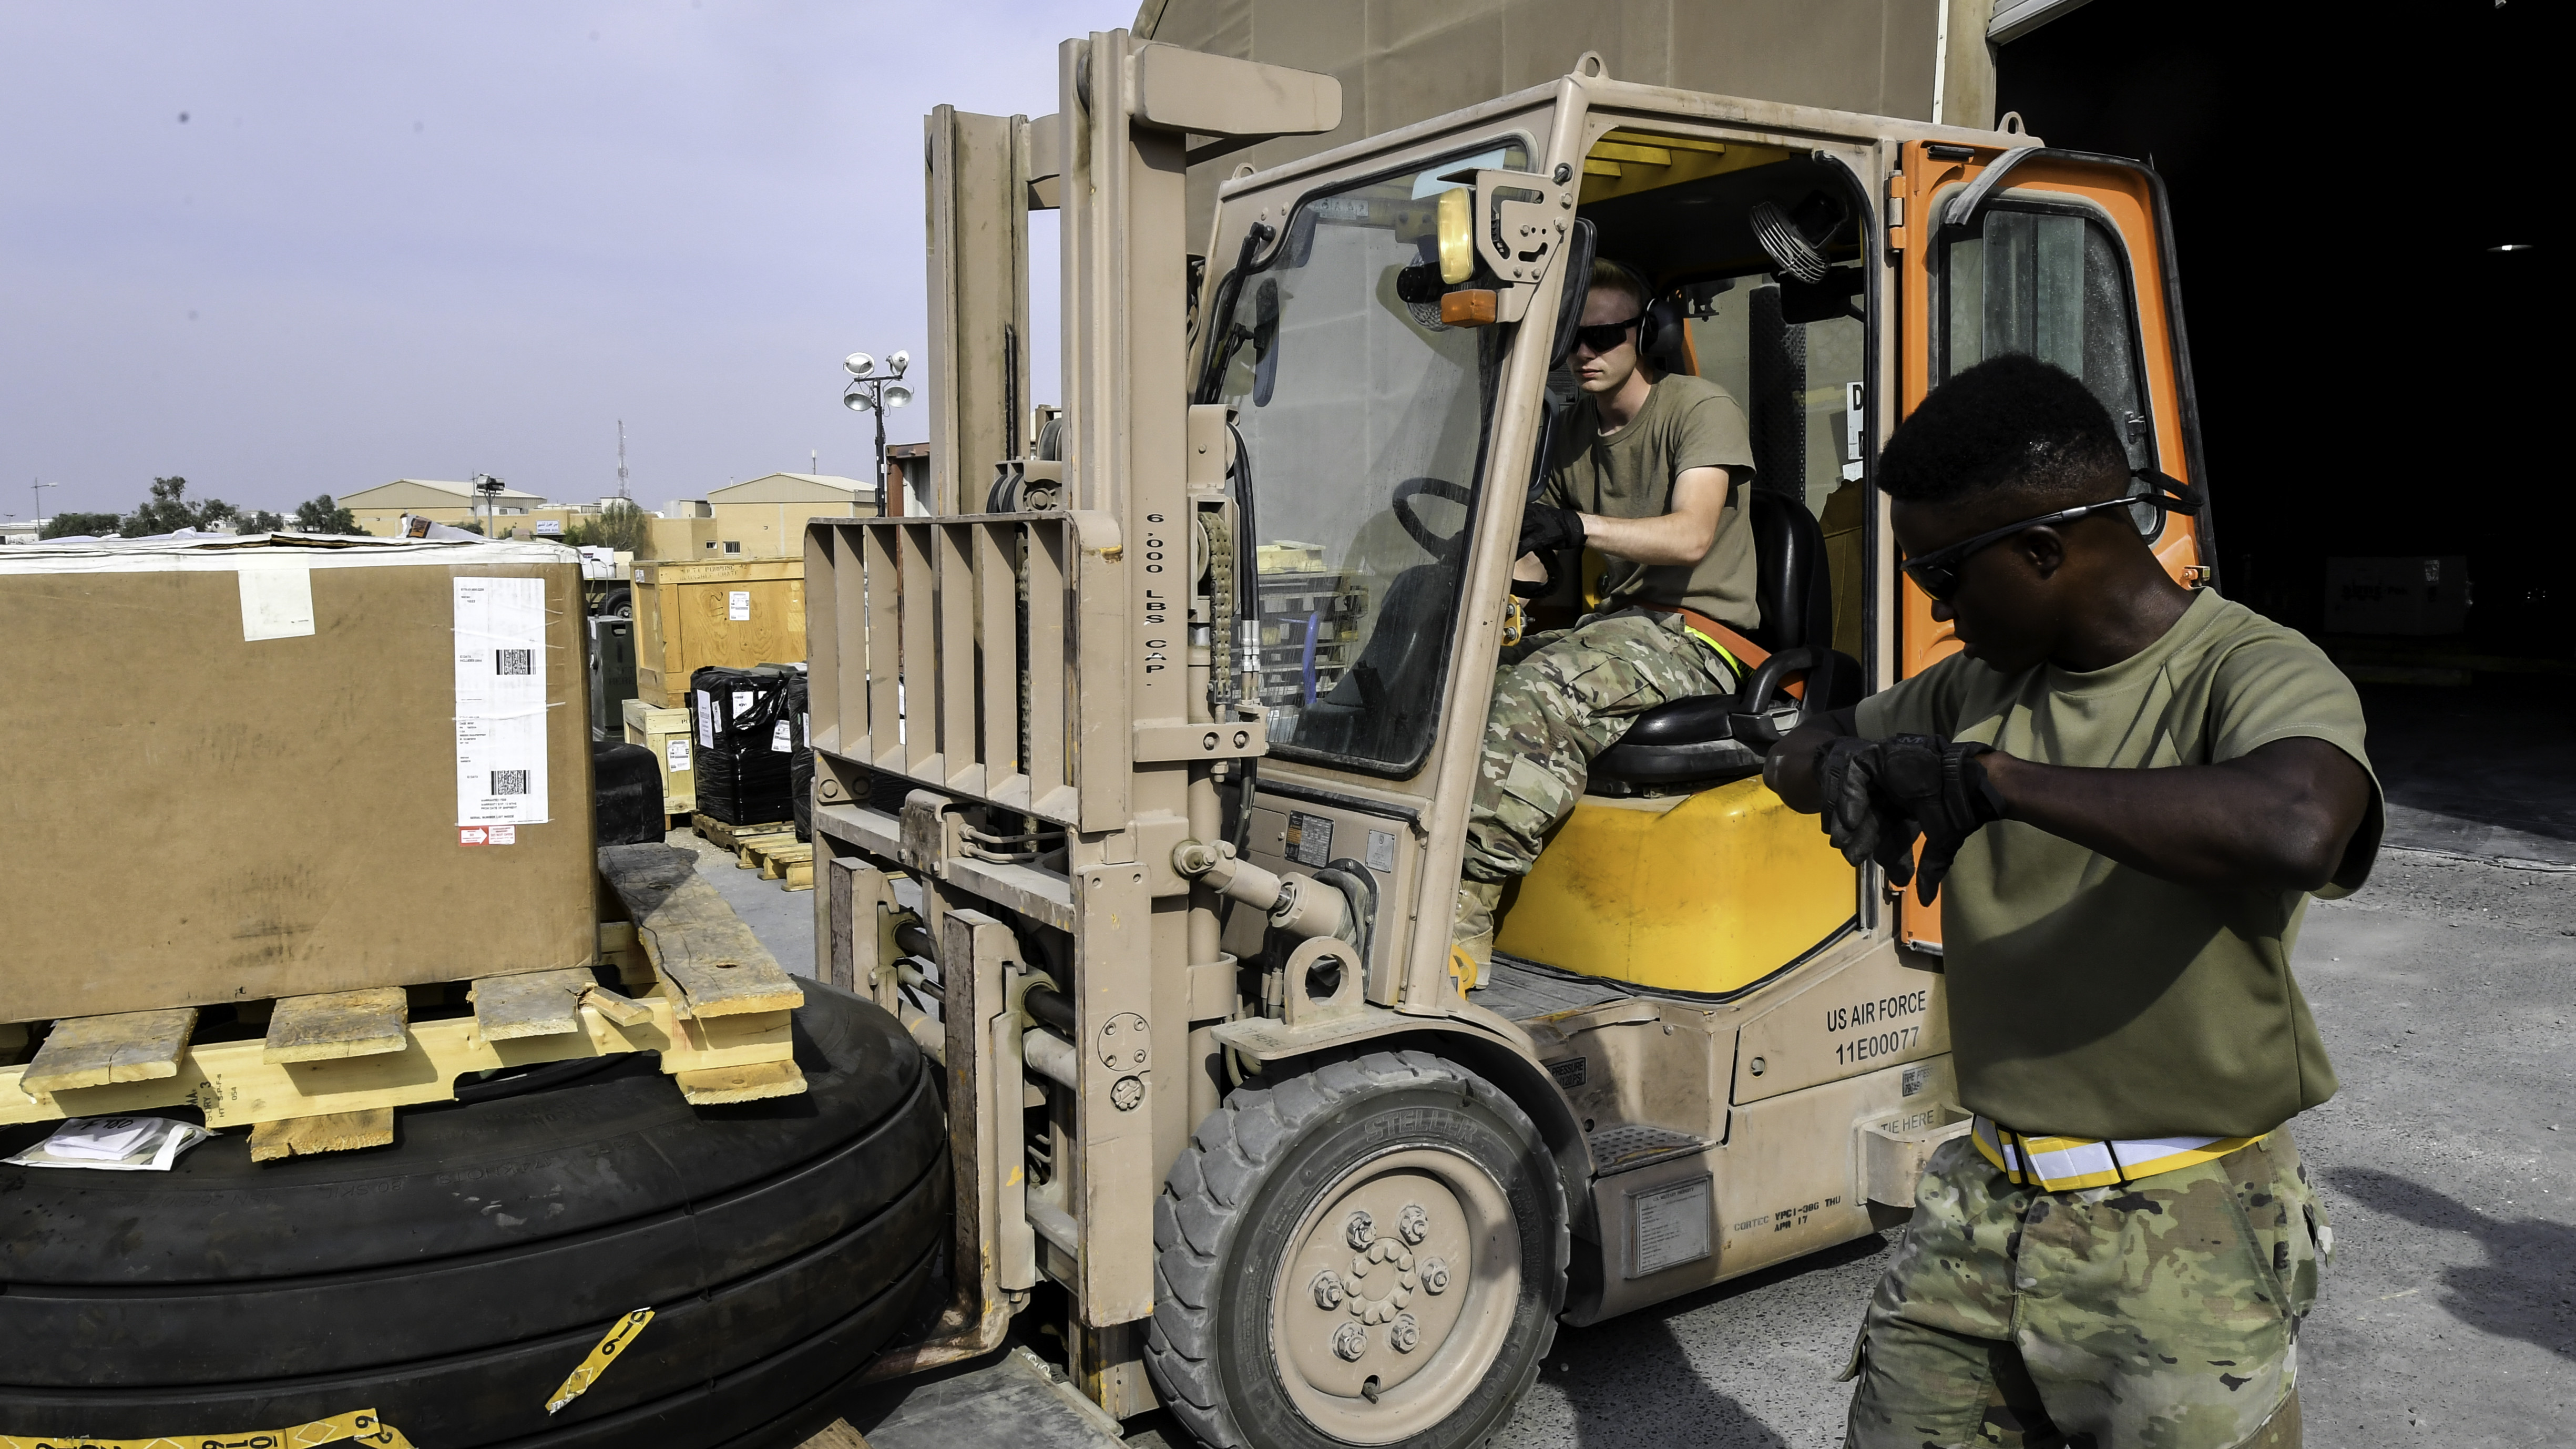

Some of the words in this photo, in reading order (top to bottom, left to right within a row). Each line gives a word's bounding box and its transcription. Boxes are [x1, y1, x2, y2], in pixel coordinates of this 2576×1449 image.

[1145, 589, 1167, 624] LBS
[1827, 1008, 1847, 1032] US
[1851, 1002, 1875, 1027] AIR
[1879, 989, 1926, 1021] FORCE
[1836, 1026, 1919, 1065] 11E00077
[1551, 1060, 1583, 1077] PRESSURE
[1903, 1110, 1934, 1132] HERE
[1824, 1195, 1841, 1207] THU
[1774, 1220, 1791, 1232] APR
[1798, 1215, 1808, 1225] 17
